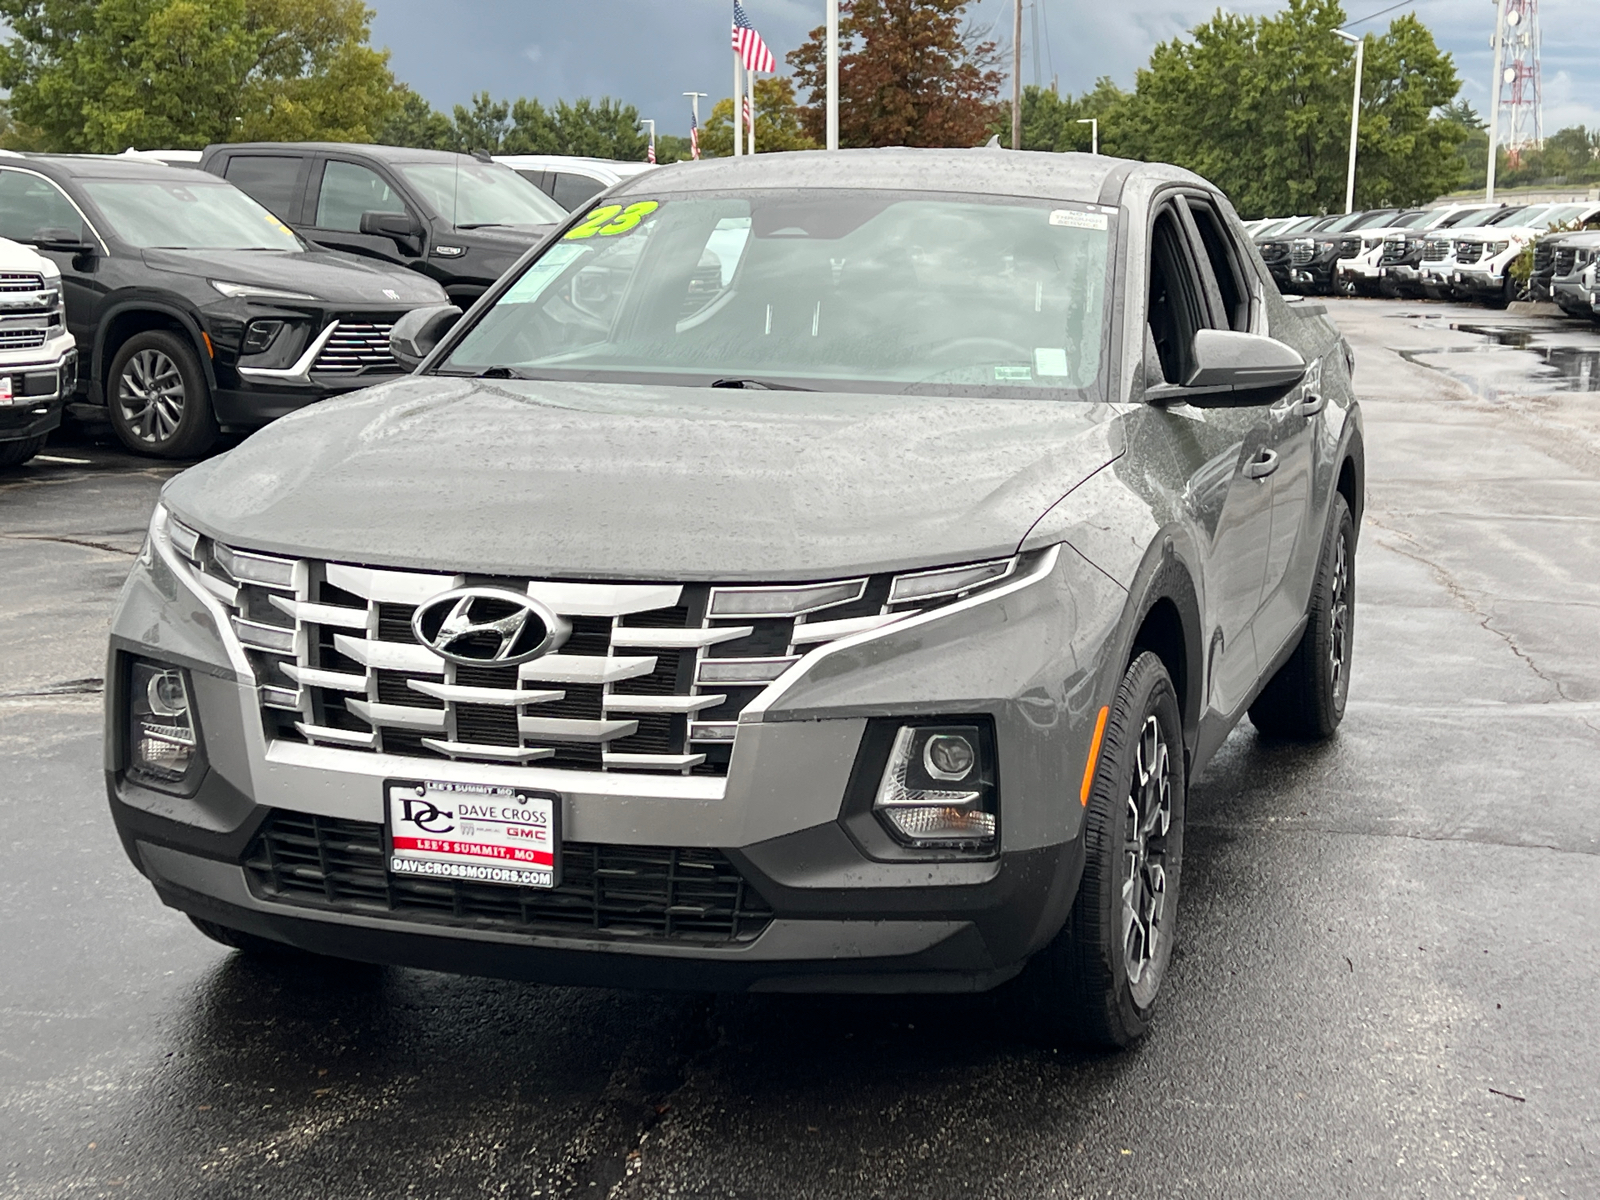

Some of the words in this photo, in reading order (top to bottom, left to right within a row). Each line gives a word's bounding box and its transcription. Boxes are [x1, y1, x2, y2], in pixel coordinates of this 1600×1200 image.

[563, 201, 658, 239] 23
[426, 782, 453, 791] LEE'S
[455, 785, 493, 795] SUMMIT
[497, 788, 513, 796] MO
[458, 804, 498, 818] DAVE
[501, 808, 547, 824] CROSS
[506, 827, 547, 841] GMC
[416, 839, 450, 851] LEE'S
[453, 843, 510, 860] SUMMIT,
[514, 850, 534, 861] MO
[393, 858, 551, 885] DAVECROSSMOTORS.COM
